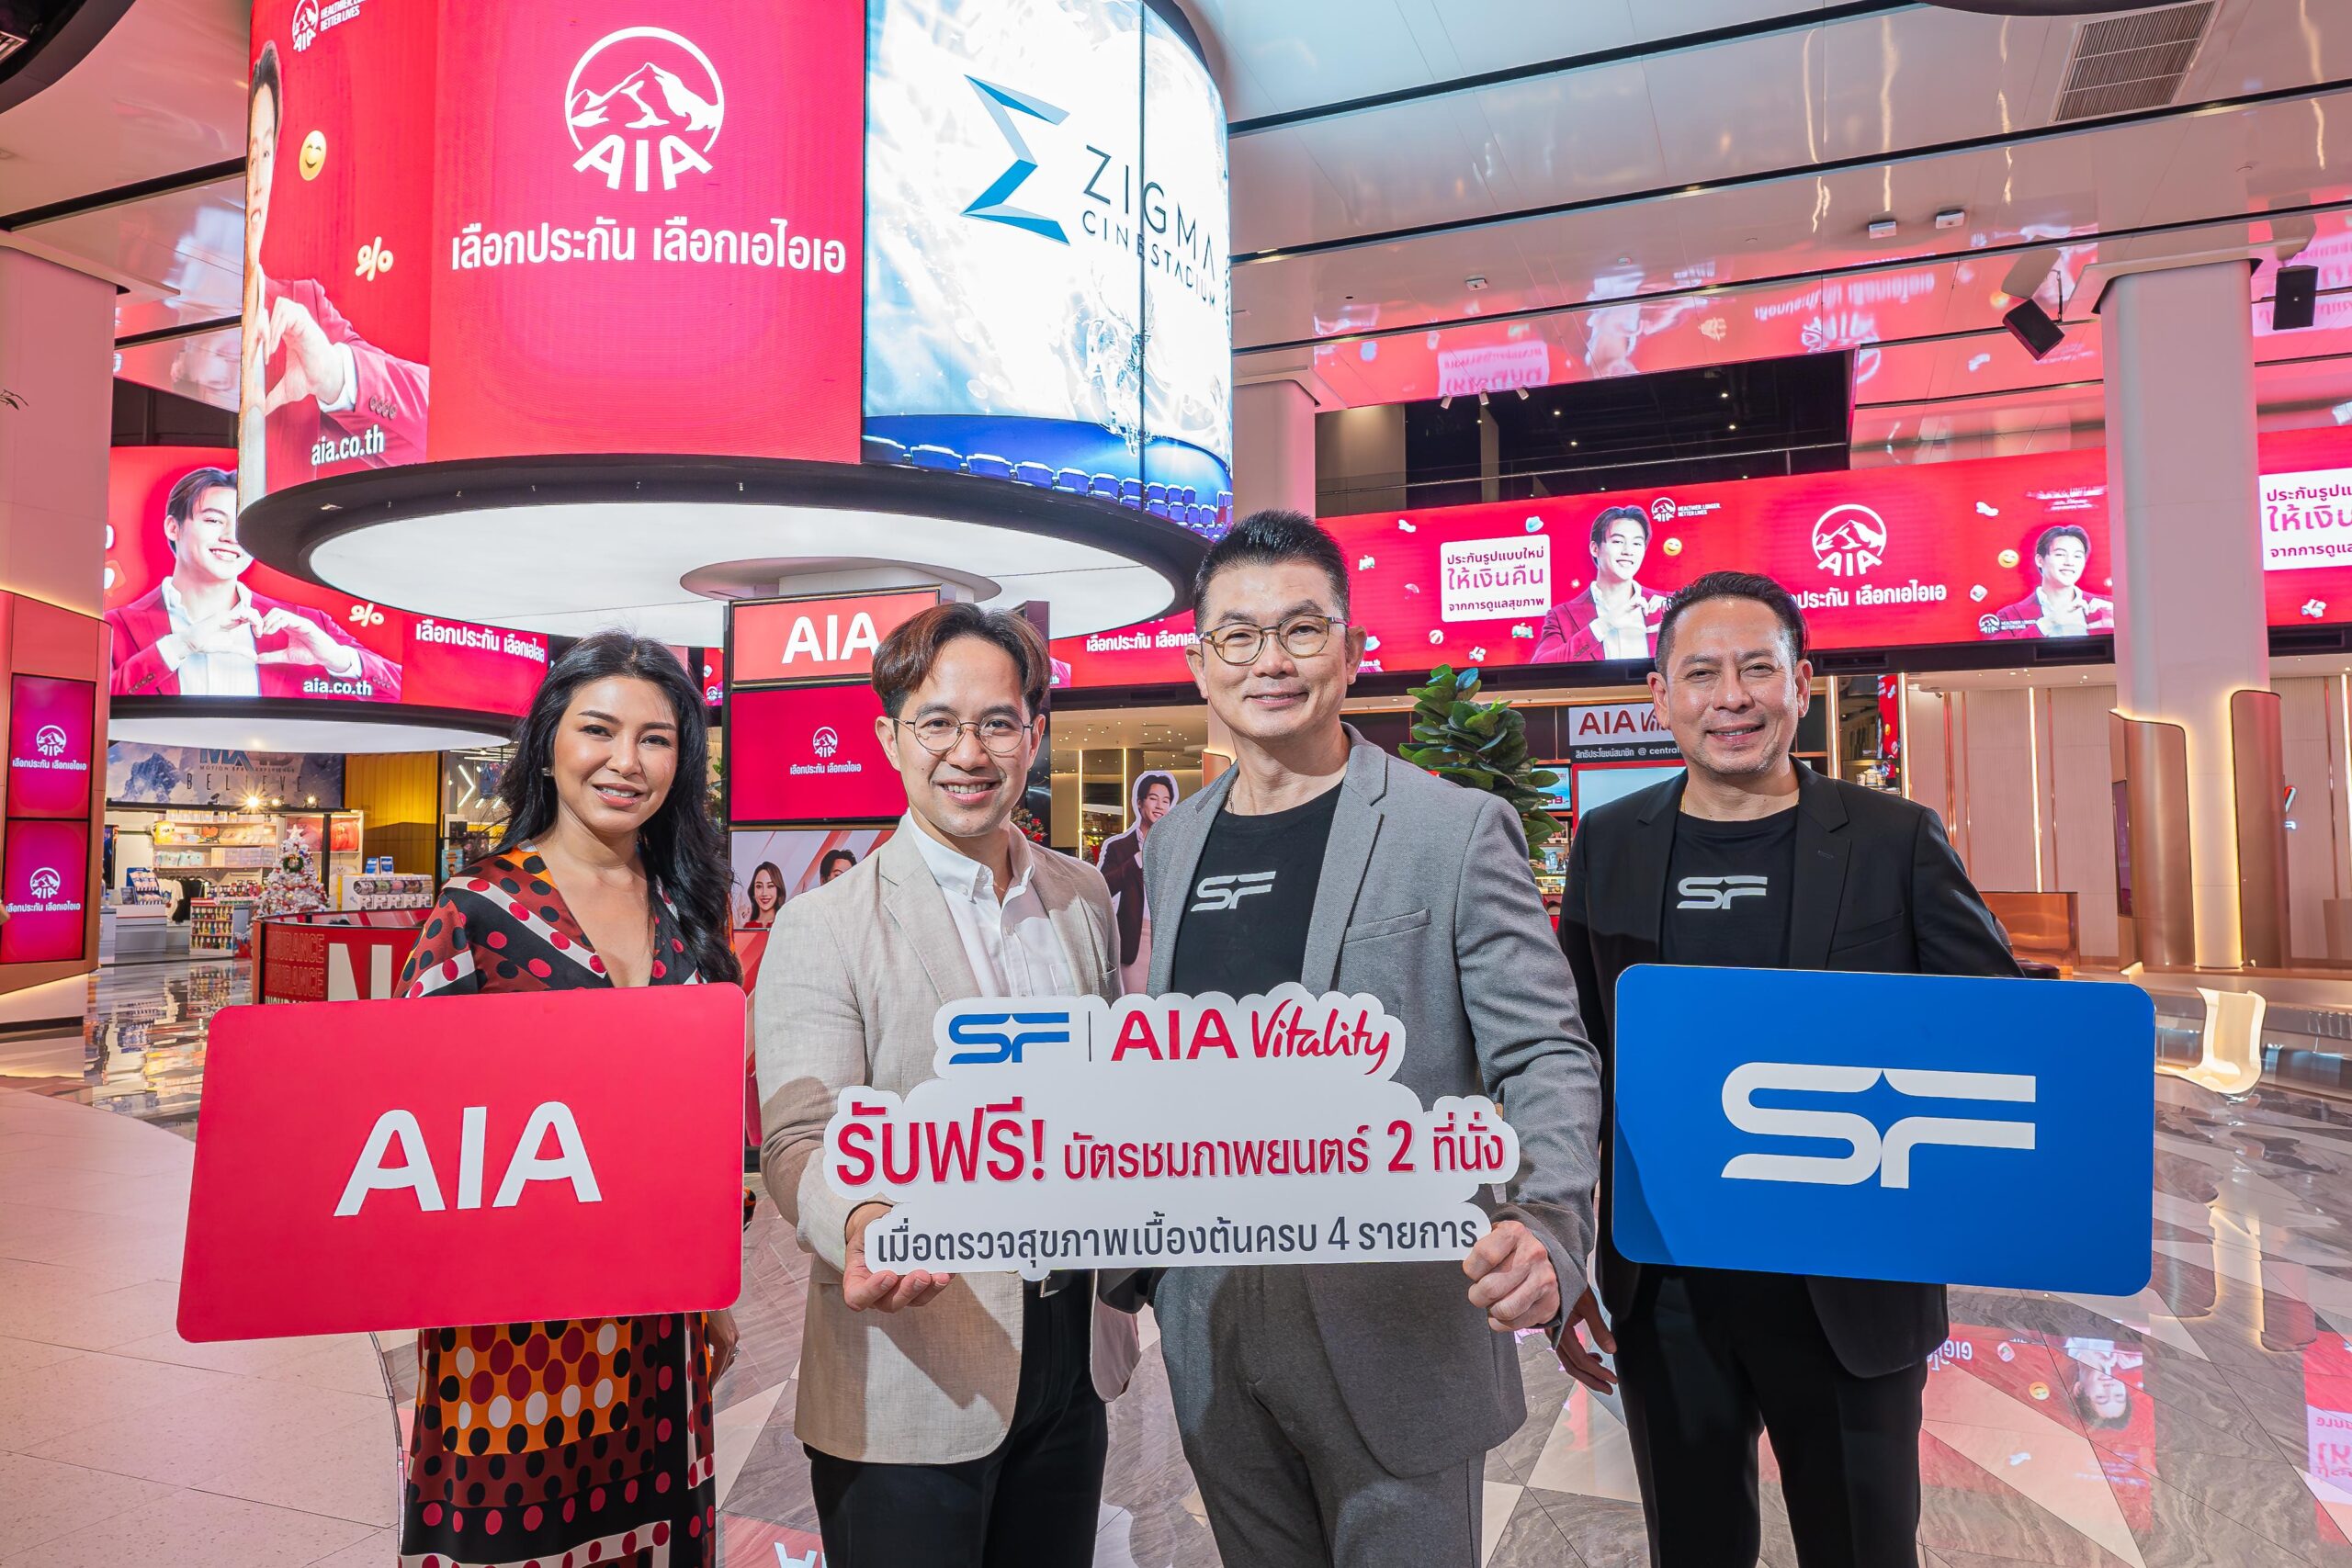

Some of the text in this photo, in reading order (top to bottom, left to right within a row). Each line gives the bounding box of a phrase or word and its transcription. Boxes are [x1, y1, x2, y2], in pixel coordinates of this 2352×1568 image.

[293, 28, 317, 52] AIA
[572, 134, 713, 192] AIA
[1083, 144, 1216, 282] ZIGMA
[451, 215, 847, 274] เลือกประกัน เลือกเอไอเอ
[1082, 209, 1216, 310] CINESTADIUM
[311, 425, 385, 466] aia.co.th
[1447, 546, 1544, 565] ประกันรูปแบบใหม่
[1817, 549, 1883, 577] AIA
[1447, 564, 1544, 591] ให้เงินคืน
[1449, 597, 1544, 612] จากการดูแลสุขภาพ
[1856, 579, 1947, 606] เลือกเอไอเอ
[415, 618, 546, 664] เลือกประกัน เลือกเอไอเอ
[781, 611, 880, 665] AIA
[1086, 632, 1151, 653] เลือกประกัน
[302, 677, 373, 696] aia.co.th
[1578, 709, 1636, 736] AIA
[13, 757, 50, 769] เลือกประกัน
[38, 744, 64, 756] AIA
[814, 746, 837, 758] AIA
[1637, 747, 1646, 756] @
[1649, 746, 1681, 755] central
[790, 761, 862, 775] เลือกประกัน เลือกเอไอเอ
[187, 773, 302, 793] BELIEVE
[31, 886, 58, 898] AIA
[1190, 870, 1277, 912] SF
[1677, 874, 1769, 910] SF
[948, 998, 1391, 1076] SF AIA Vitality
[1720, 1061, 2037, 1189] SF
[836, 1095, 1506, 1187] รับฟรี! บัตรชมภาพยนตร์ 2 ที่นั่ง
[334, 1100, 602, 1217] AIA
[877, 1211, 1478, 1269] เมื่อตรวจสุขภาพเบื้องต้นครบ 4 รายการ
